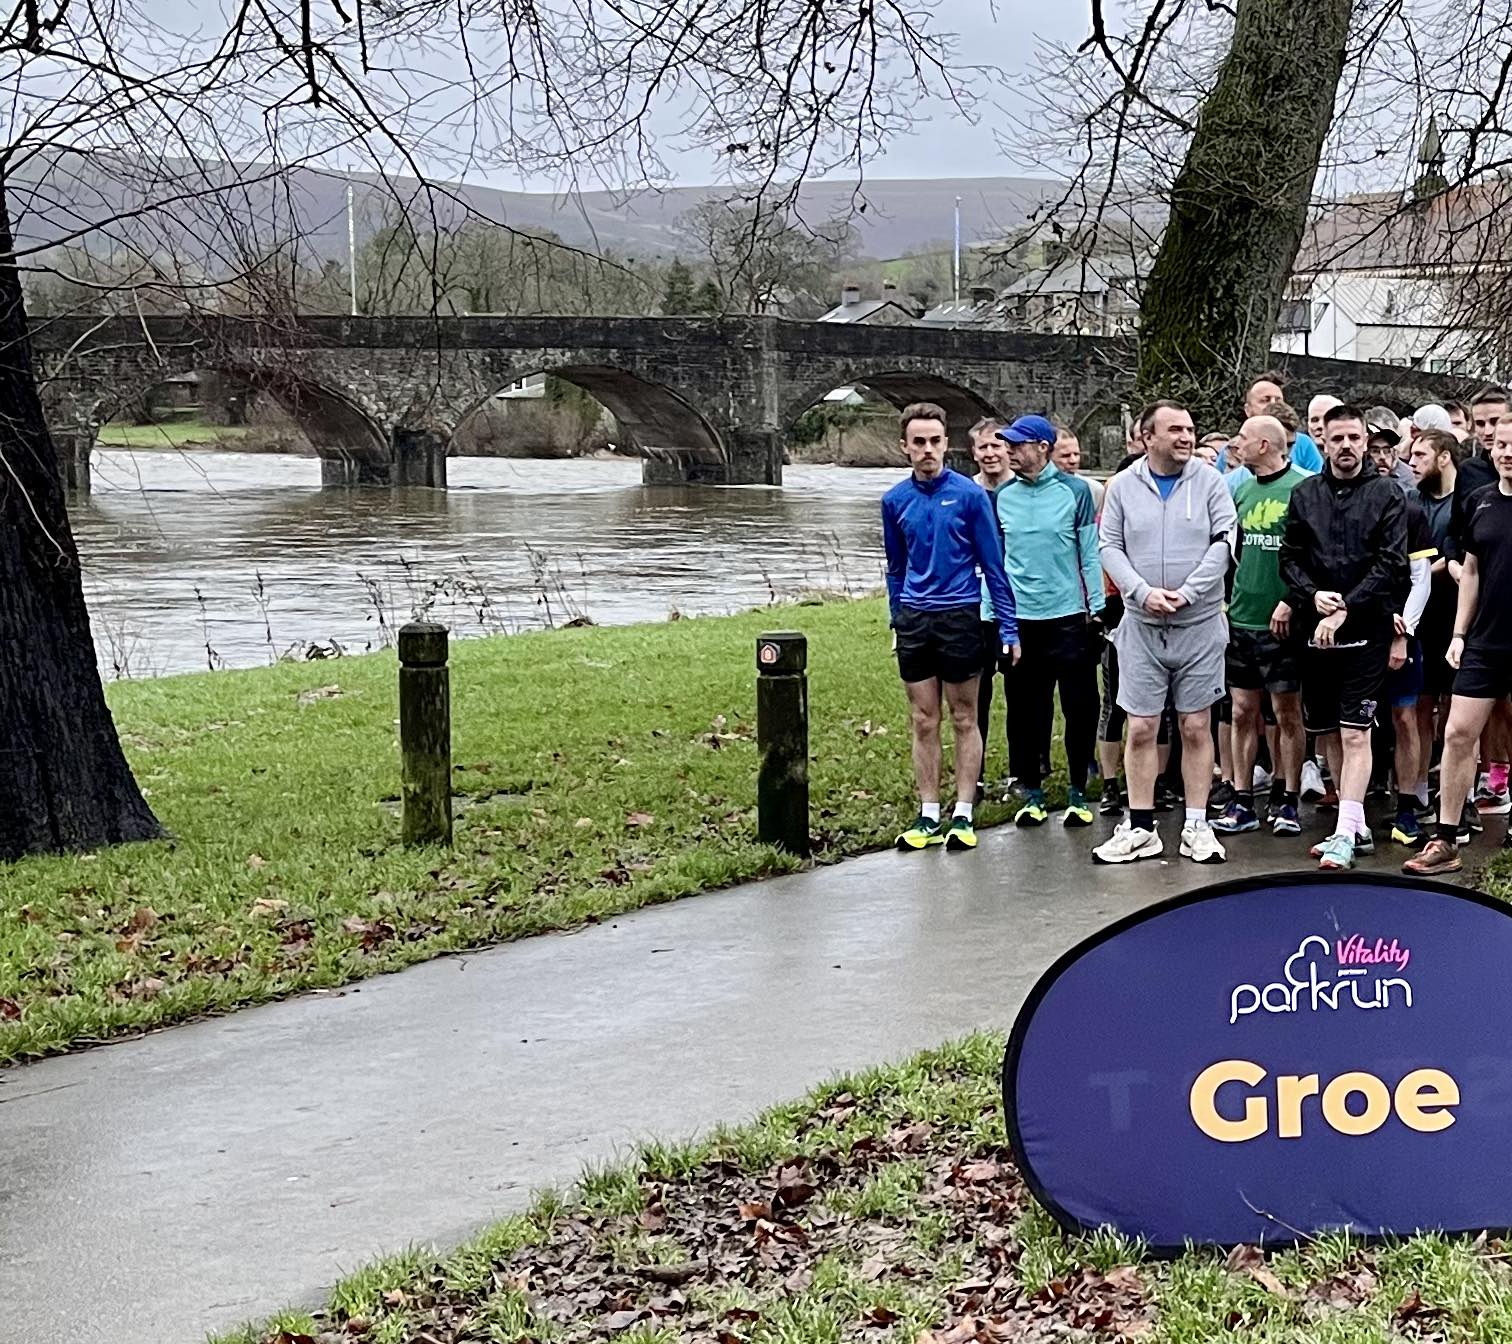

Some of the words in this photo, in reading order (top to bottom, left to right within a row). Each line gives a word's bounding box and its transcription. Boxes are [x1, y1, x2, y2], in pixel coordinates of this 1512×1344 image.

[1229, 935, 1412, 1024] parkrun
[1337, 933, 1410, 973] Vitality
[1189, 1059, 1460, 1143] Groe
